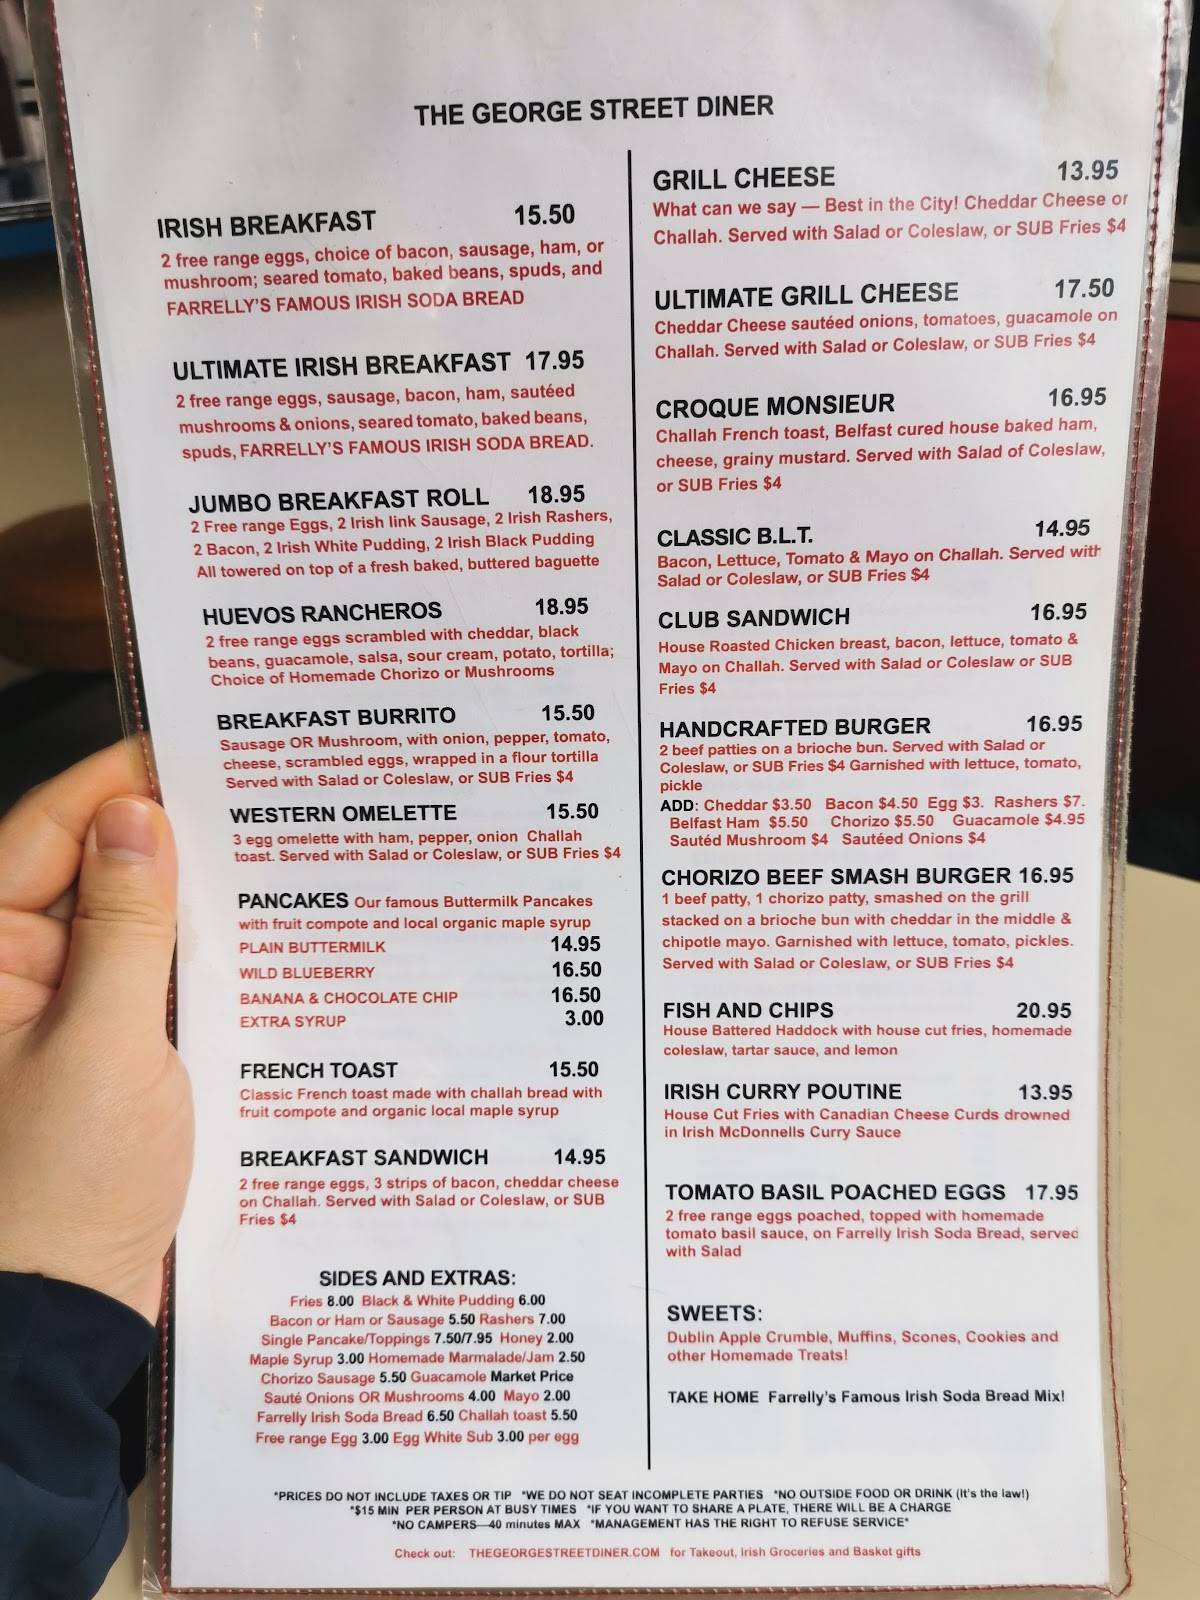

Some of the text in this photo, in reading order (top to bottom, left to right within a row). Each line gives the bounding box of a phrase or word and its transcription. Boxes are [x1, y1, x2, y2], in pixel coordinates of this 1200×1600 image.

[414, 95, 774, 126] THE GEORGE STREET DINER
[653, 160, 1118, 191] GRILL CHEESE 13.95
[157, 203, 575, 238] IRISH BREAKFAST 15.50
[276, 295, 350, 312] FAMOUS
[356, 294, 401, 310] IRISH
[408, 292, 458, 308] SODA
[463, 290, 524, 306] BREAD
[655, 278, 1114, 310] ULTIMATE GRILL CHEESE 17.50
[173, 350, 584, 381] ULTIMATE IRISH BREAKFAST 17.95
[656, 387, 1106, 419] CROQUE MONSIEUR 16.95
[656, 442, 1104, 470] cheese, grainy mustard. Served with Salad of Coleslaw,
[189, 485, 585, 513] JUMBO BREAKFAST ROLL 18.95
[657, 519, 1090, 547] CLASSIC B.L.T. 14.95
[203, 597, 588, 625] HUEVOS RANCHEROS 18.95
[659, 603, 1087, 629] CLUB SANDWICH 16.95
[659, 633, 1078, 653] House Roasted Chicken breast, bacon, lettuce, tomato &
[217, 704, 594, 730] BREAKFAST BURRITO 15.50
[661, 715, 1082, 738] HANDCRAFTED BURGER 16.95
[229, 803, 598, 823] WESTERN OMELETTE 15.50
[662, 867, 1073, 886] CHORIZO BEEF SMASH BURGER 16.95
[238, 892, 593, 909] PANCAKES Our famous Buttermilk Pancakes
[240, 936, 600, 954] PLAIN BUTTERMILK 14.95
[240, 961, 601, 979] WILD BLUEBERRY 16.50
[240, 987, 600, 1005] BANANA & CHOCOLATE CHIP 16.50
[240, 1010, 604, 1028] EXTRA SYRUP 3.00
[664, 1002, 1071, 1018] FISH AND CHIPS 20.95
[664, 1024, 1072, 1037] House Battered Haddock with house cut fries, homemade
[241, 1061, 598, 1079] FRENCH TOAST 15.50
[665, 1083, 1072, 1100] IRISH CURRY POUTINE 13.95
[241, 1148, 605, 1167] BREAKFAST SANDWICH 14.95
[665, 1184, 1078, 1200] TOMATO BASIL POACHED EGGS 17.95
[320, 1270, 515, 1286] SIDES AND EXTRAS:
[668, 1305, 761, 1321] SWEETS:
[668, 1330, 1058, 1346] Dublin Apple Crumble, Muffins, Scones, Cookies and
[261, 1370, 574, 1387] Chorizo Sausage 5.50 Guacamole Market Price
[668, 1391, 708, 1403] TAKE
[714, 1391, 759, 1403] HOME
[842, 1391, 900, 1403] Famous
[906, 1390, 938, 1402] Irish
[943, 1390, 980, 1402] Soda
[986, 1389, 1029, 1401] Bread
[1035, 1390, 1064, 1402] Mix!
[395, 1546, 921, 1559] Check out: THEGEORGESTREETDINER.COM for Takeout, Irish Groceries and Basket gifts
